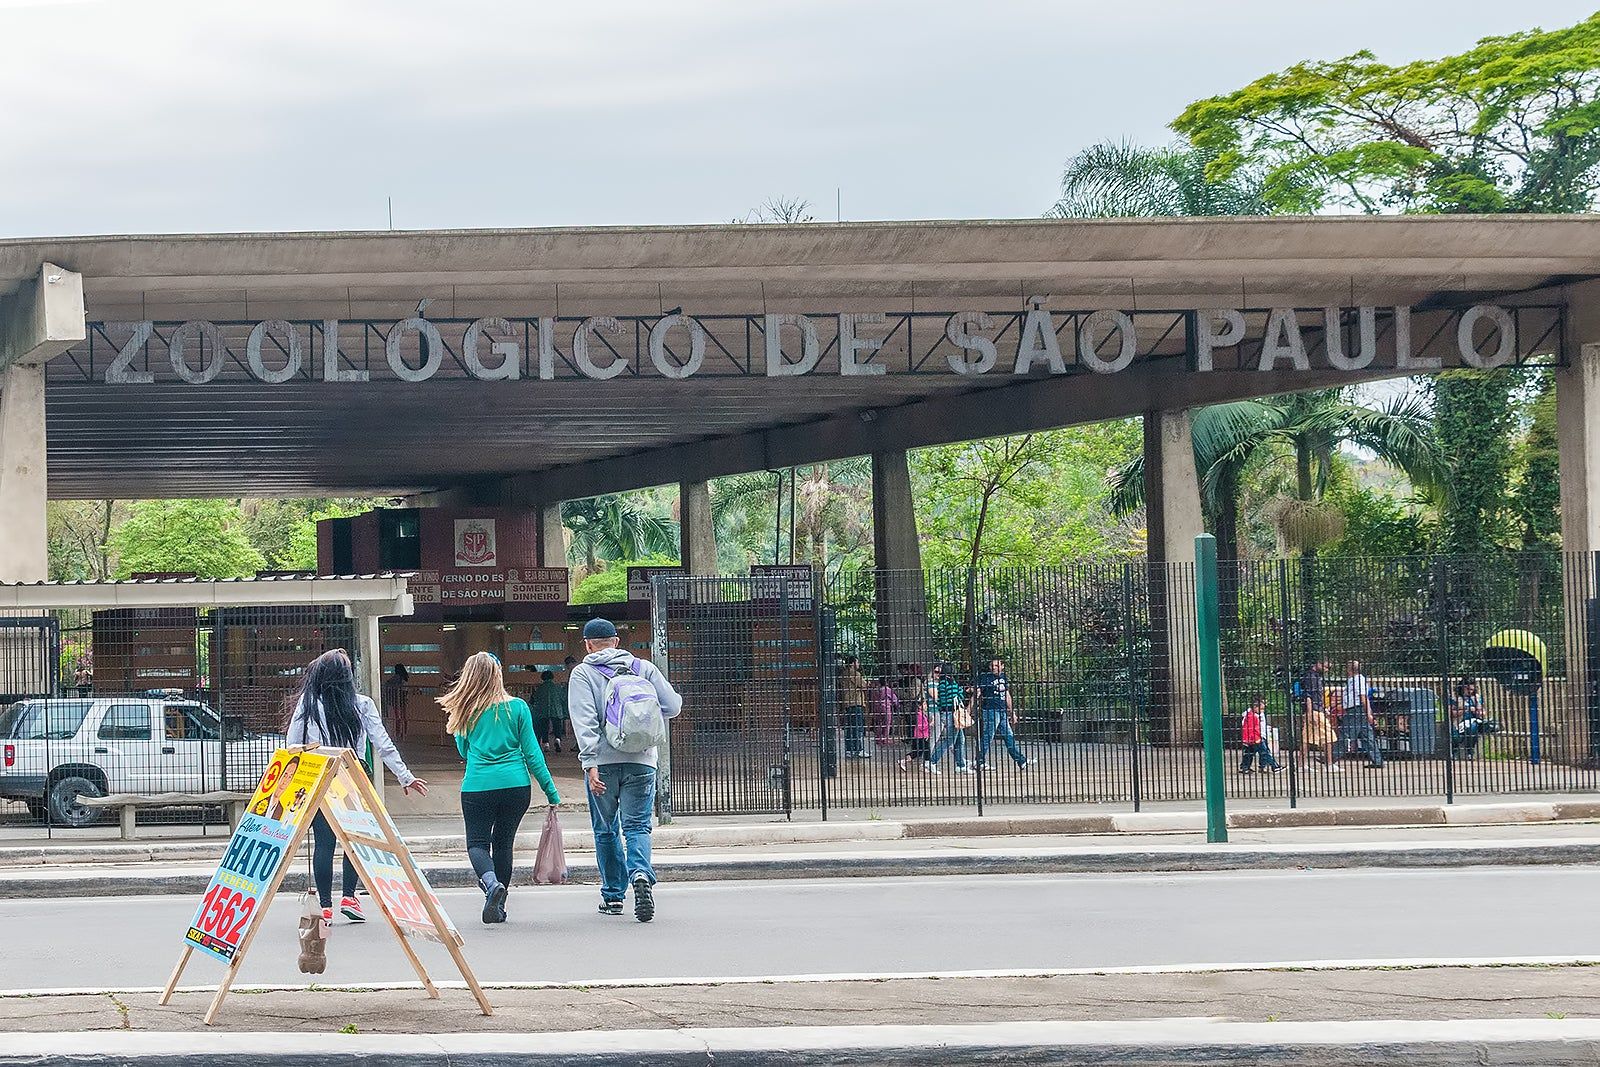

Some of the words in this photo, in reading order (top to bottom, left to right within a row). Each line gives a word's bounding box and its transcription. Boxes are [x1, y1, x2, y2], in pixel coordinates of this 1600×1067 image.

[104, 299, 707, 384] ZOOLÓGICO
[766, 312, 886, 377] DE
[945, 295, 1137, 375] SÃO
[1198, 305, 1517, 372] PAULO
[475, 574, 489, 582] DO
[491, 574, 504, 582] ES
[406, 586, 434, 594] ENTE
[442, 590, 456, 598] DE
[457, 587, 479, 598] SÃO
[512, 585, 560, 593] SOMENTE
[512, 593, 561, 601] DINHEIRO
[220, 871, 258, 895] FEDERAL
[196, 884, 256, 945] 1562
